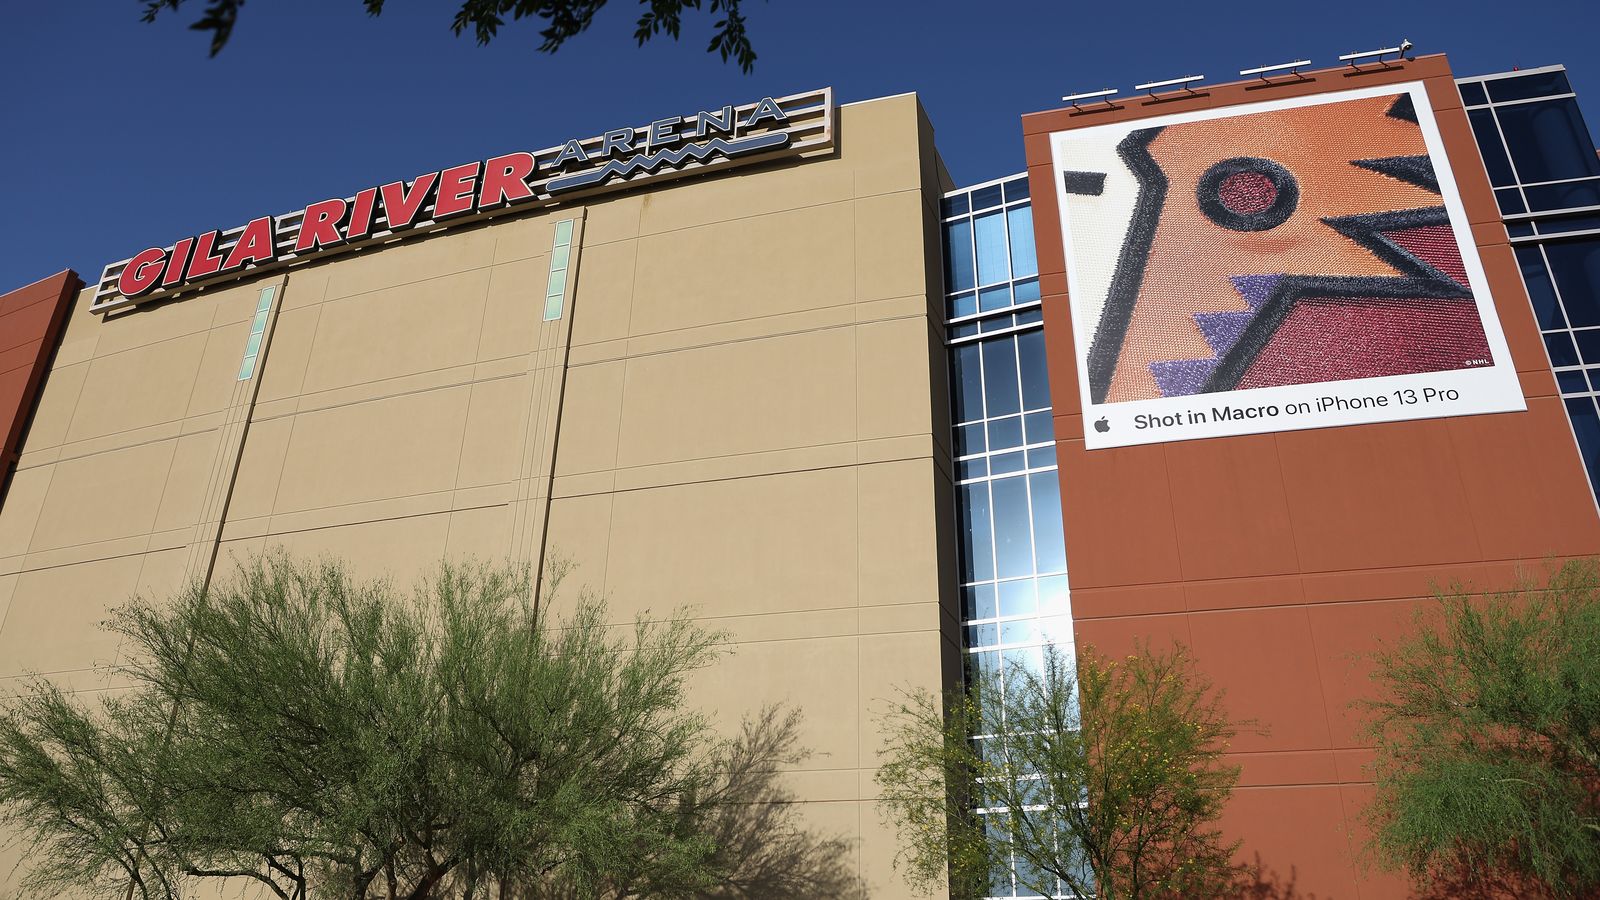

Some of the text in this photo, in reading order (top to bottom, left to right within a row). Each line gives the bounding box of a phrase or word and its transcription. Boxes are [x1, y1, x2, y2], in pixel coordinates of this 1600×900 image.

[118, 97, 788, 296] GILA RIVER ARENA
[1134, 387, 1460, 430] Shot in Macro on iPhone 13 Pro
